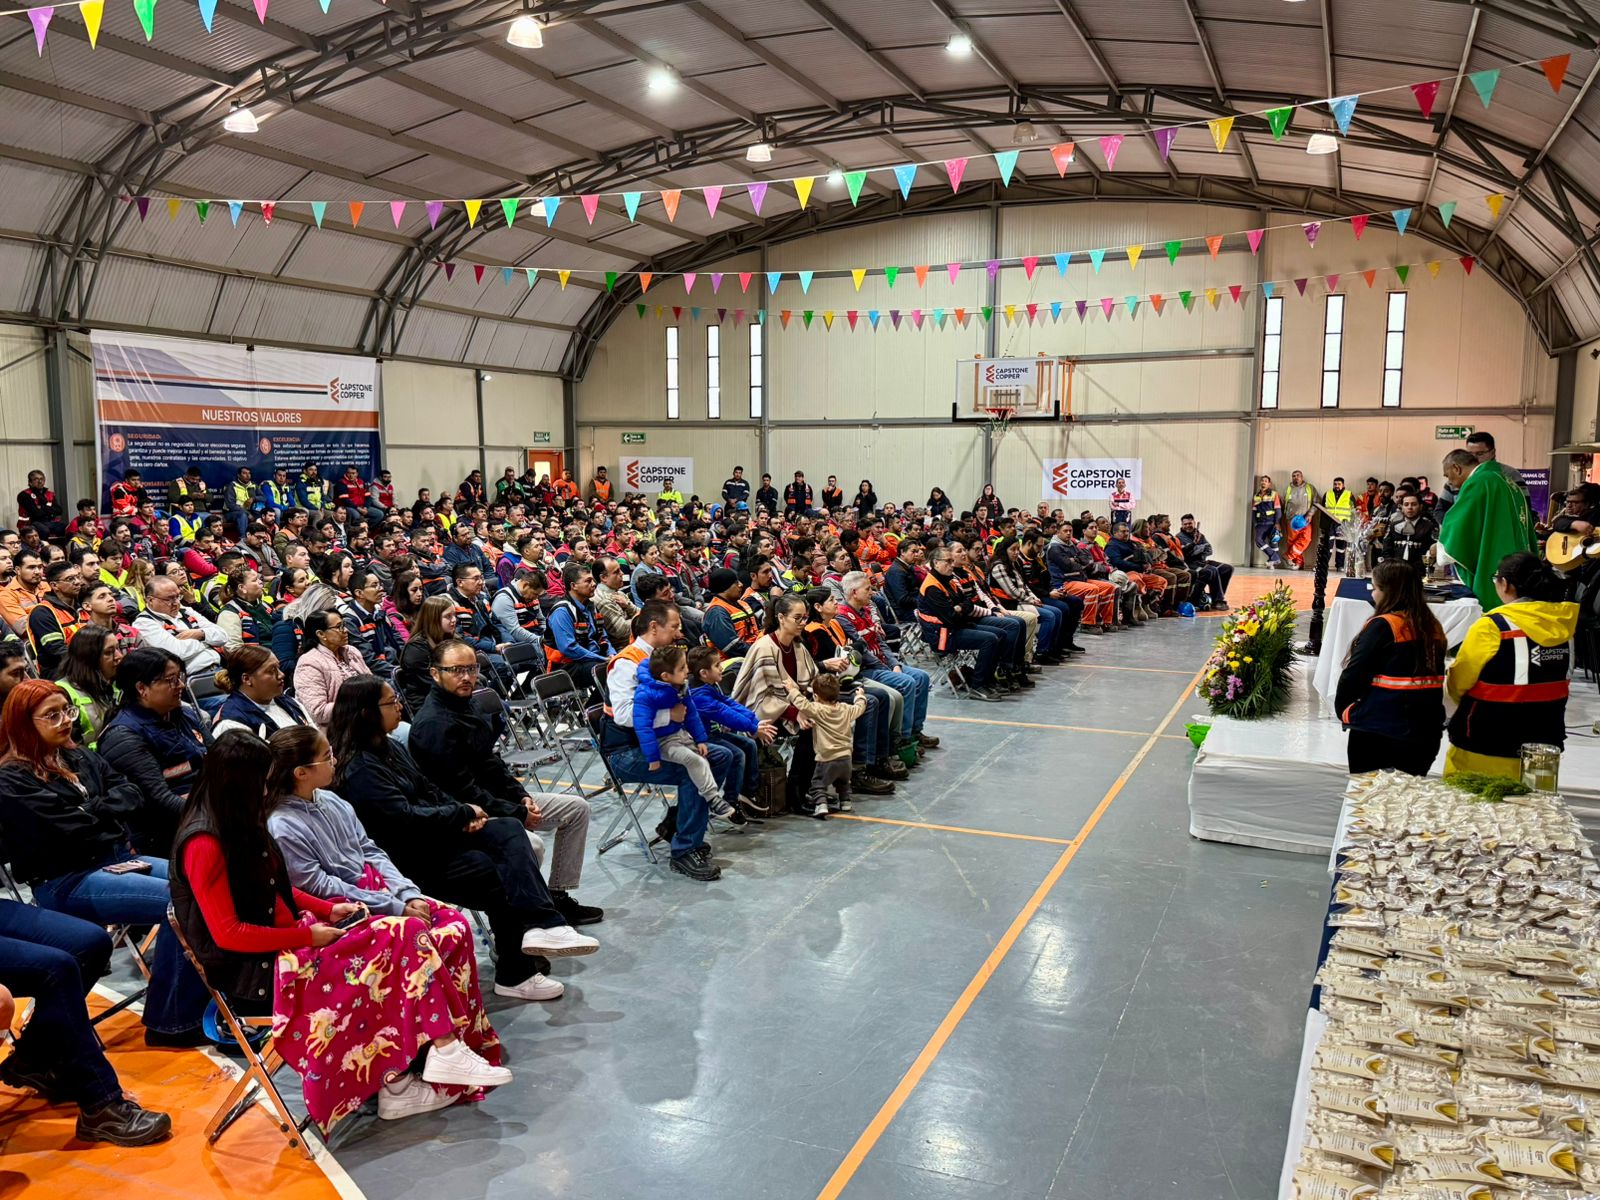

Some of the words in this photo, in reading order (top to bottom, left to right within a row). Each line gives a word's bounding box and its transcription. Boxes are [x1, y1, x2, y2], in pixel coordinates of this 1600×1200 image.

[340, 383, 372, 392] CAPSTONE
[340, 391, 365, 399] COPPER
[202, 409, 258, 422] NUESTROS
[259, 411, 302, 423] VALORES
[640, 466, 686, 475] CAPSTONE
[1070, 470, 1131, 478] CAPSTONE
[1070, 480, 1115, 488] COPPER
